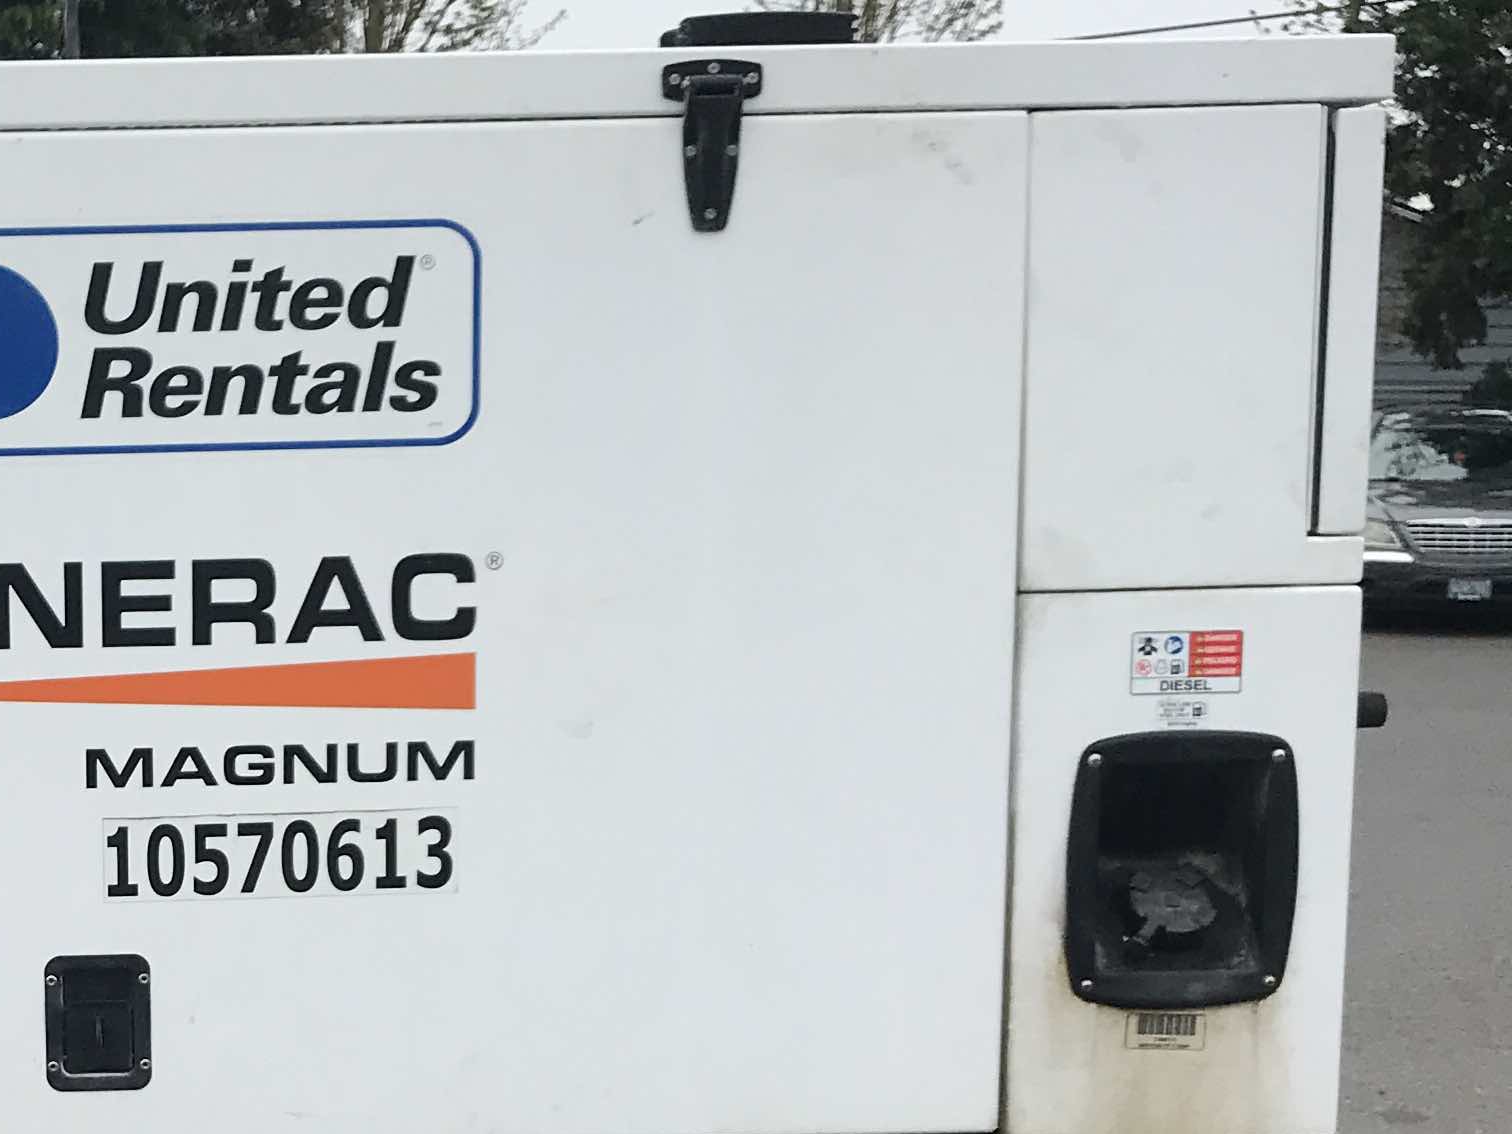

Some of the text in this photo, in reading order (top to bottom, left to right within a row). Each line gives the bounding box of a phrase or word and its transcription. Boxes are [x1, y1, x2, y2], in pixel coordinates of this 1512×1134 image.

[84, 255, 416, 335] United
[80, 340, 442, 420] Rentals
[1159, 680, 1212, 691] DIESEL
[85, 740, 476, 789] MAGNUM
[105, 816, 455, 898] 10570613
